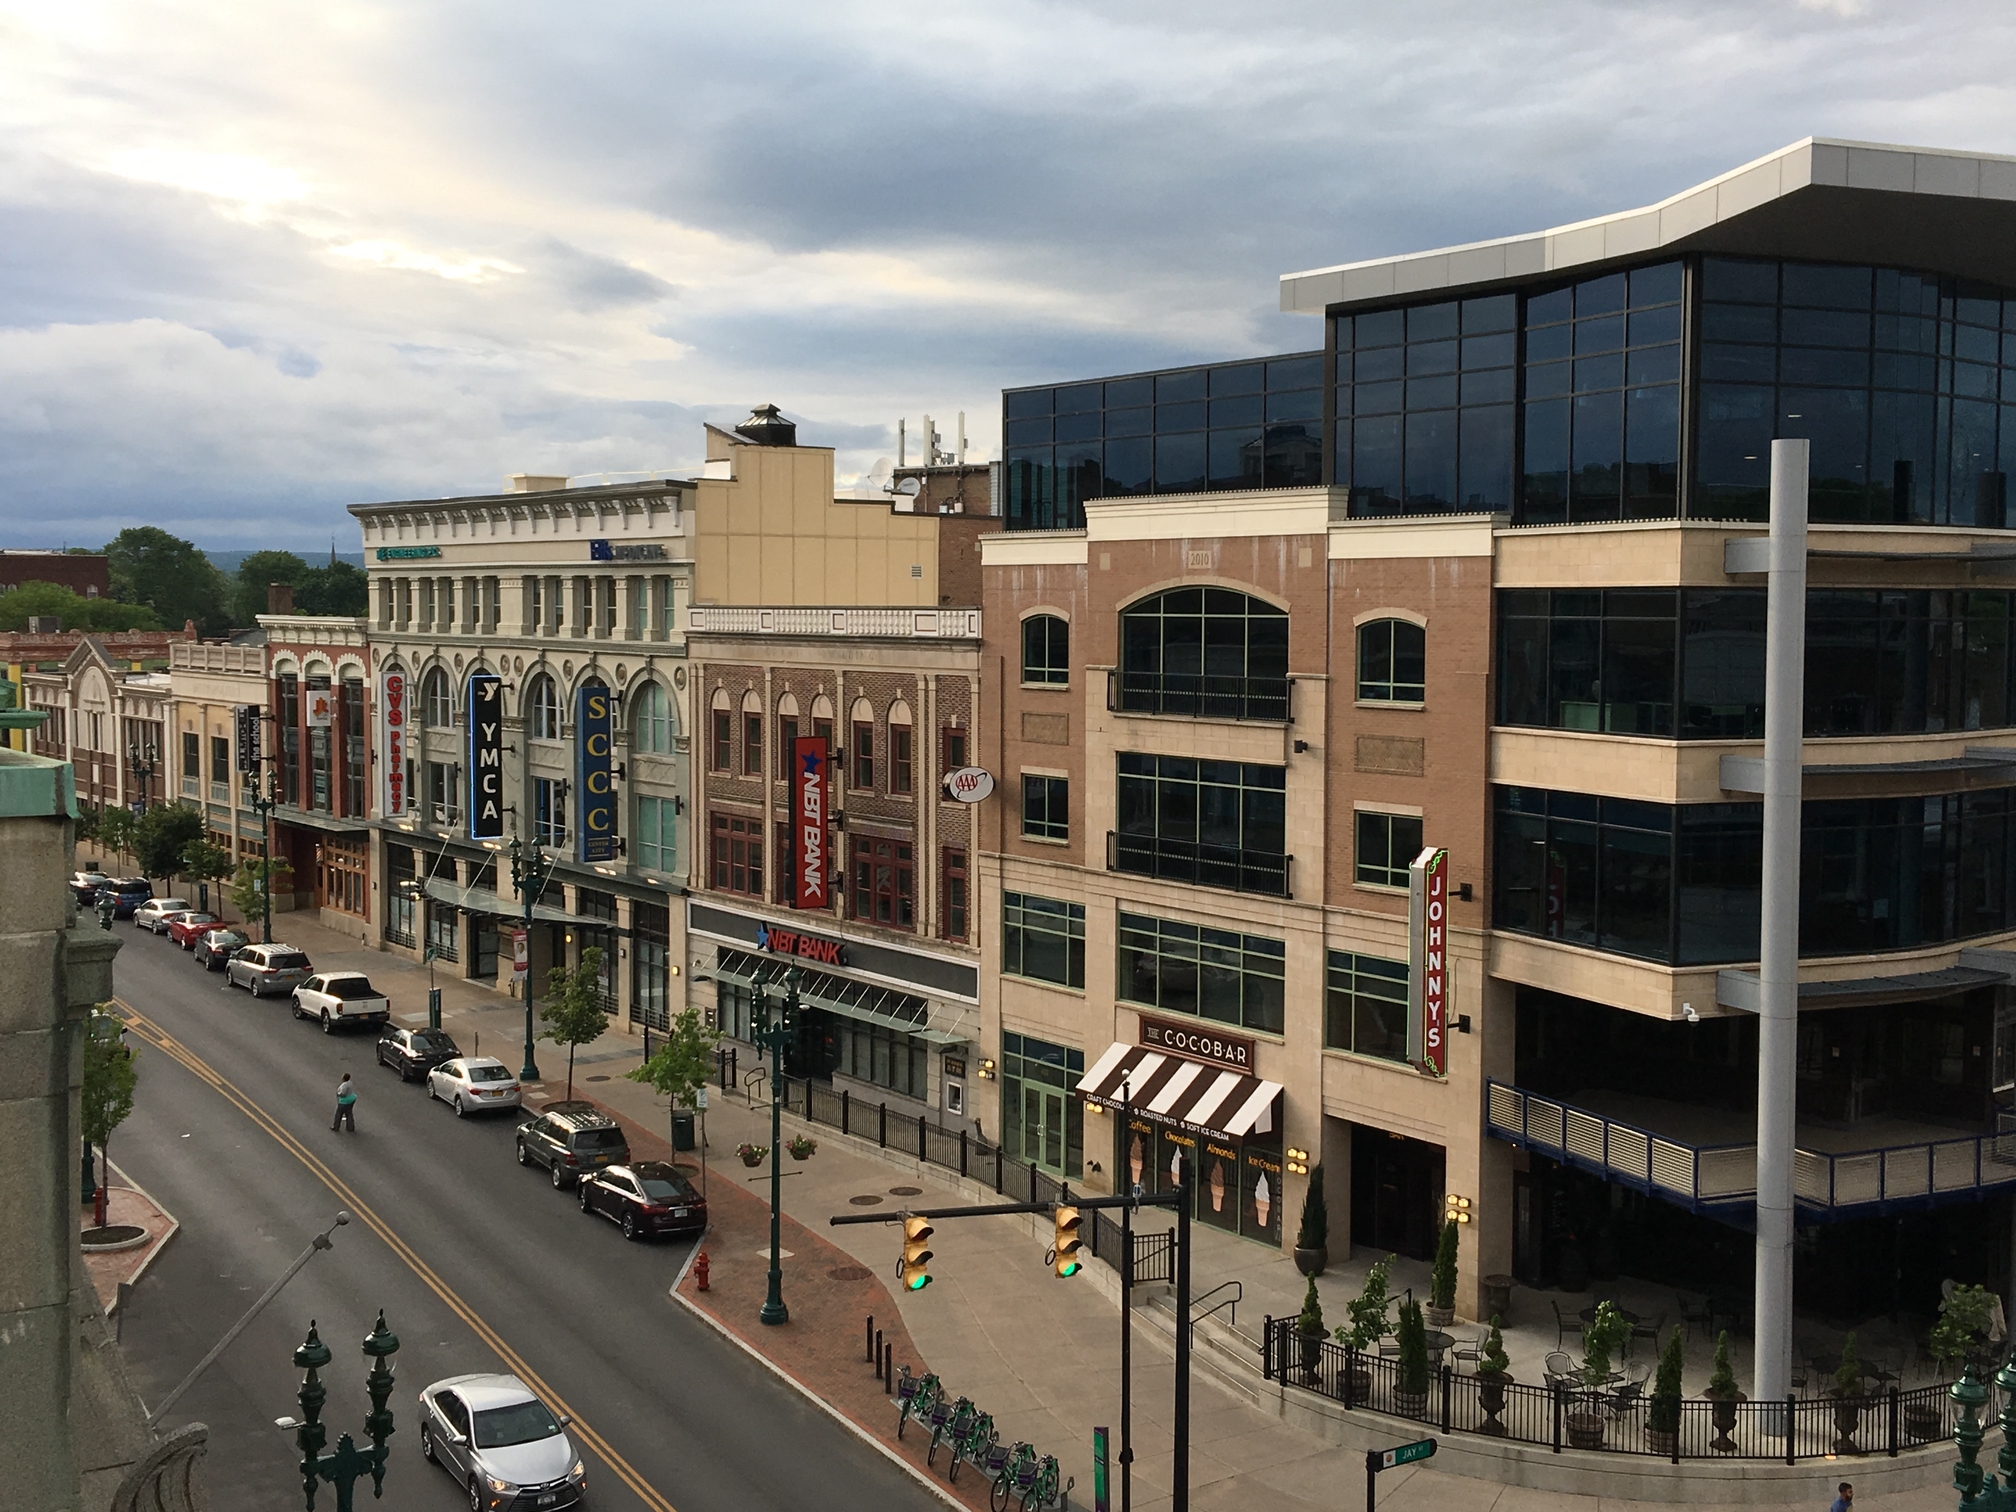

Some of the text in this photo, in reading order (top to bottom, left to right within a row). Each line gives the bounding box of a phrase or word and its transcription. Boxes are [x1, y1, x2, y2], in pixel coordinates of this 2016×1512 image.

[1191, 553, 1210, 565] 2010
[387, 676, 403, 726] CVS
[249, 717, 260, 761] the school
[480, 723, 499, 820] YMCA
[587, 696, 609, 830] SCCC
[955, 774, 978, 791] AAA
[804, 772, 821, 898] NBT BANK
[767, 928, 841, 966] NBT BANK
[1428, 877, 1442, 1047] JOHNNY'S
[1147, 1027, 1159, 1039] THE
[1086, 1093, 1230, 1141] CRAFT CHOCOL ROASTED NUTS SOFT ICE CREAM
[1164, 1131, 1196, 1148] Chocolates
[1206, 1143, 1237, 1160] Almonds
[1248, 1155, 1281, 1173] Ice Cream
[1402, 1446, 1417, 1460] JAY
